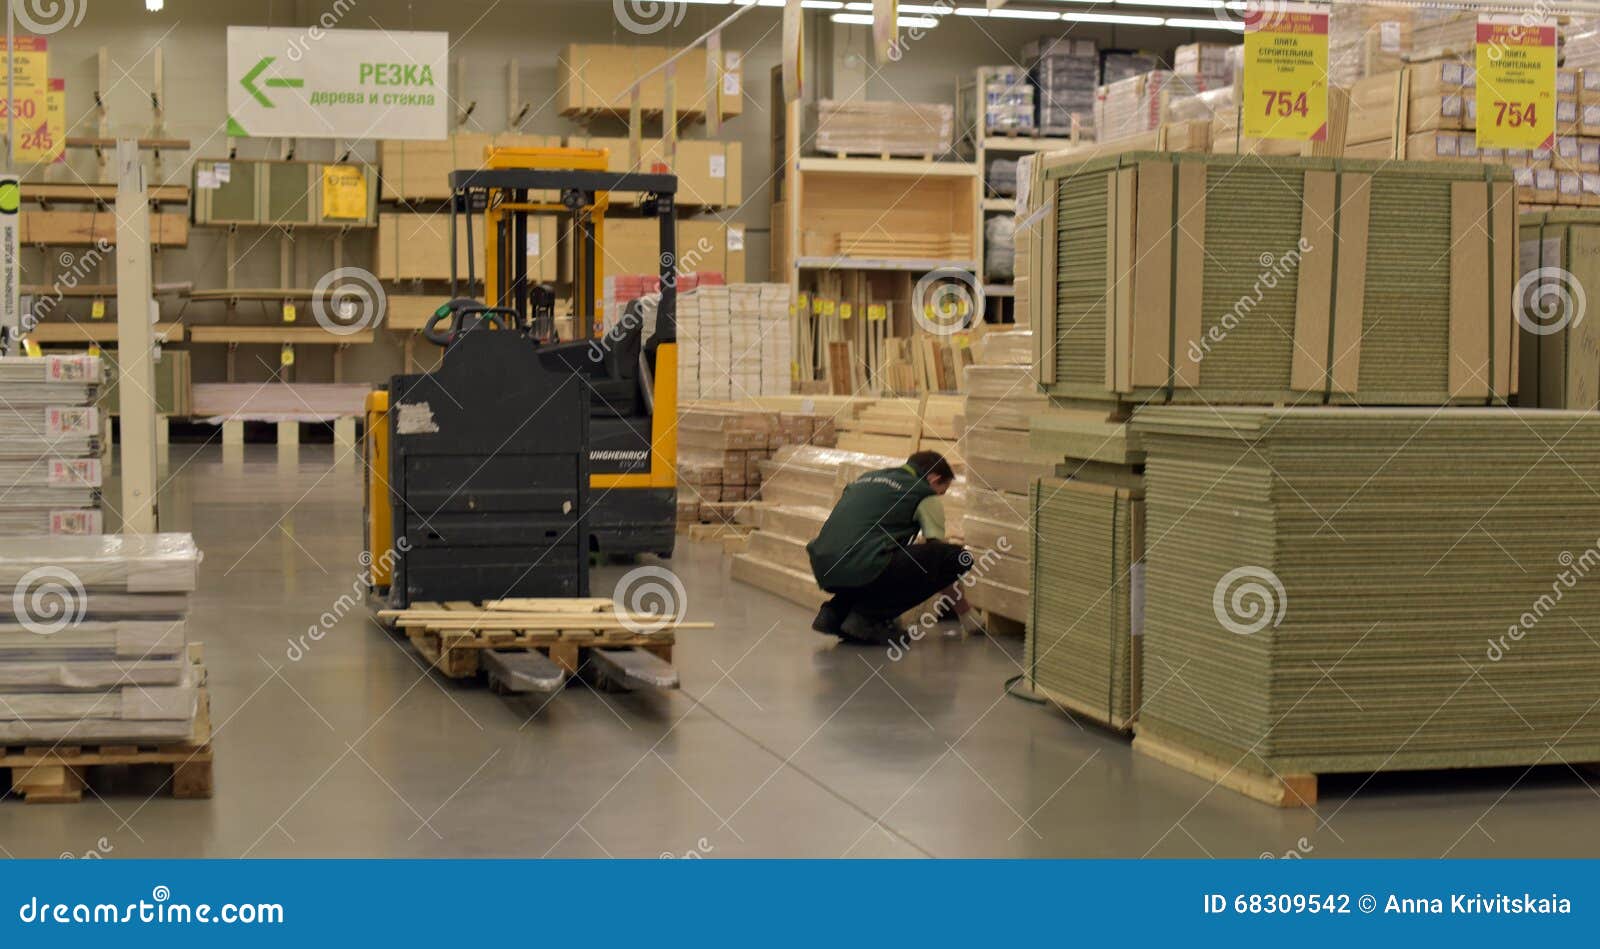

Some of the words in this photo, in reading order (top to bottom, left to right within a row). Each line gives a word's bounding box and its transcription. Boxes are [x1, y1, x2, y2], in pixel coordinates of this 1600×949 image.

[1274, 38, 1298, 46] ПЛИТА
[1258, 48, 1313, 57] СТРОИТЕЛЬНАЯ
[1504, 50, 1527, 58] ПЛИТА
[1490, 60, 1541, 69] СТРОИТЕЛЬНАЯ
[359, 63, 434, 86] РЕЗКА
[310, 91, 365, 107] дерева
[368, 92, 378, 104] и
[383, 92, 435, 106] стекла
[1262, 90, 1309, 118] 754
[1493, 101, 1537, 128] 754
[21, 132, 53, 150] 245
[589, 450, 649, 460] UNGHEINRICH
